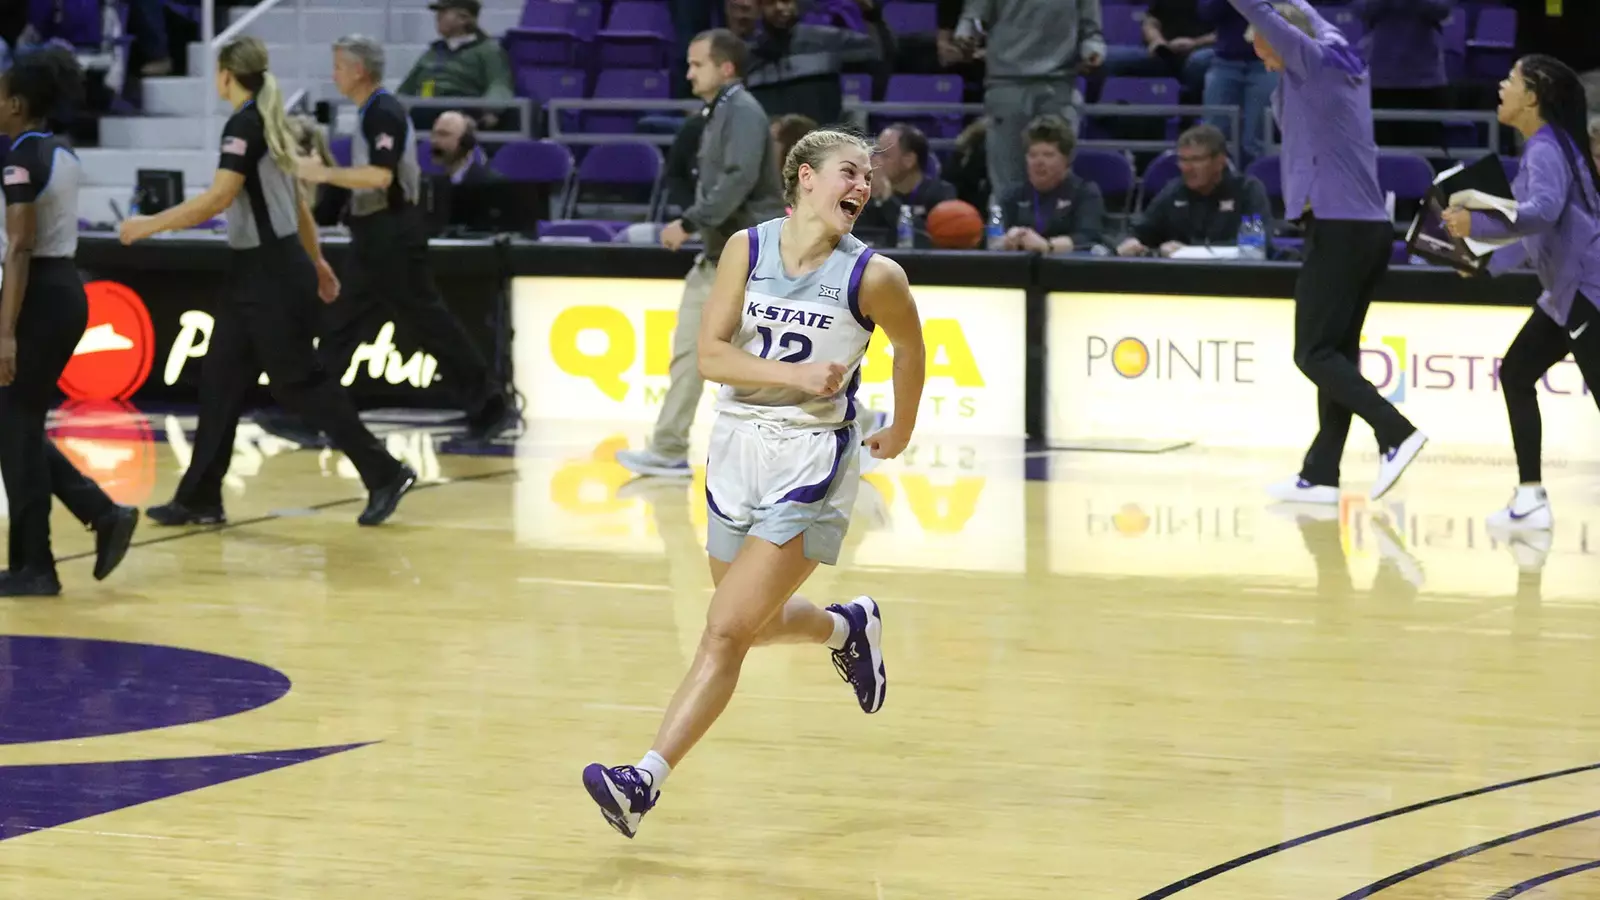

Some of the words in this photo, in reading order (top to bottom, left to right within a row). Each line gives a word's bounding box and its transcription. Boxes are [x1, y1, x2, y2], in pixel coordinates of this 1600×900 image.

[747, 302, 834, 330] K-STATE
[549, 305, 986, 402] QBA
[756, 325, 812, 363] 12
[1087, 336, 1254, 383] POINTE
[1360, 349, 1592, 396] DISTC
[869, 394, 977, 418] ETS
